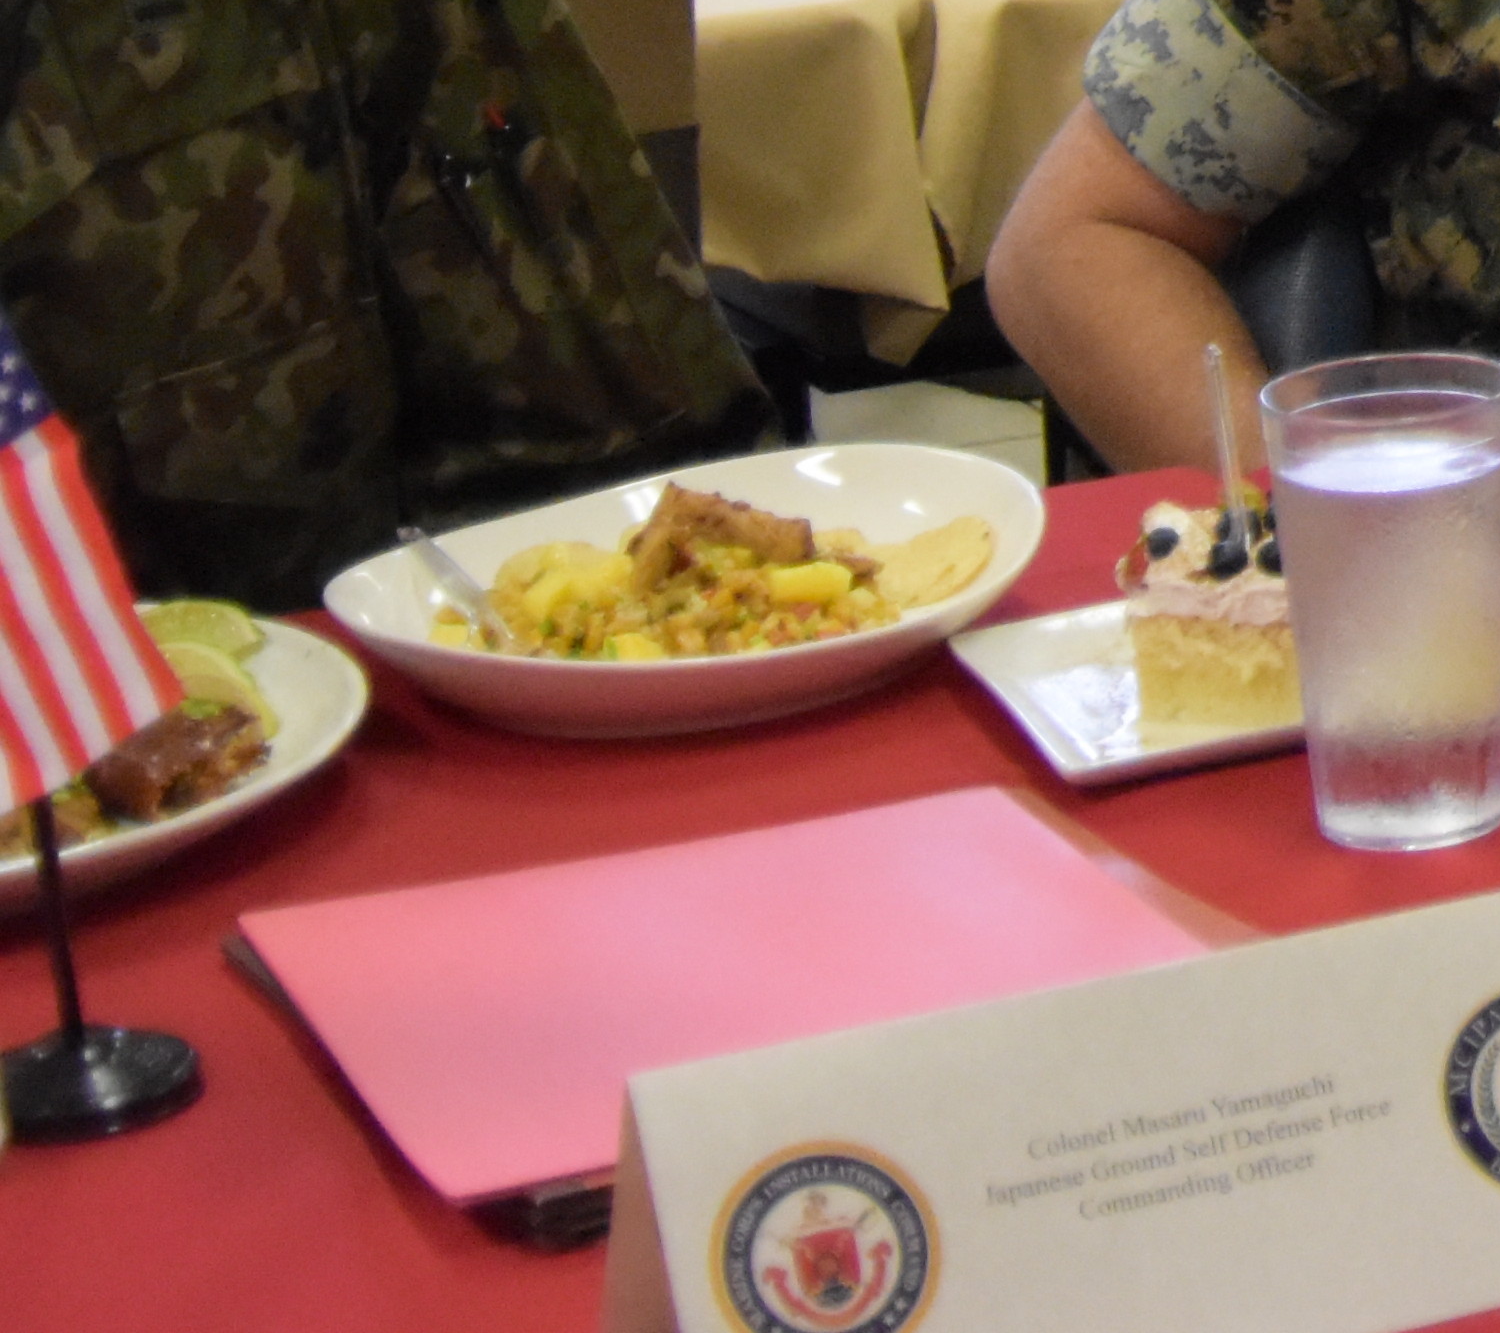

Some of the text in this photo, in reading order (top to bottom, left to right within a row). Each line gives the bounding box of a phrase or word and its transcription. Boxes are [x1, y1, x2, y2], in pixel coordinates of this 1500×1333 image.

[986, 1098, 1391, 1209] Japanese Ground Self Defense Force
[1028, 1073, 1336, 1161] Colonel Masaru Yamaguchi
[764, 1164, 892, 1199] INSTALLATIONS
[1079, 1150, 1316, 1220] Commanding Officer
